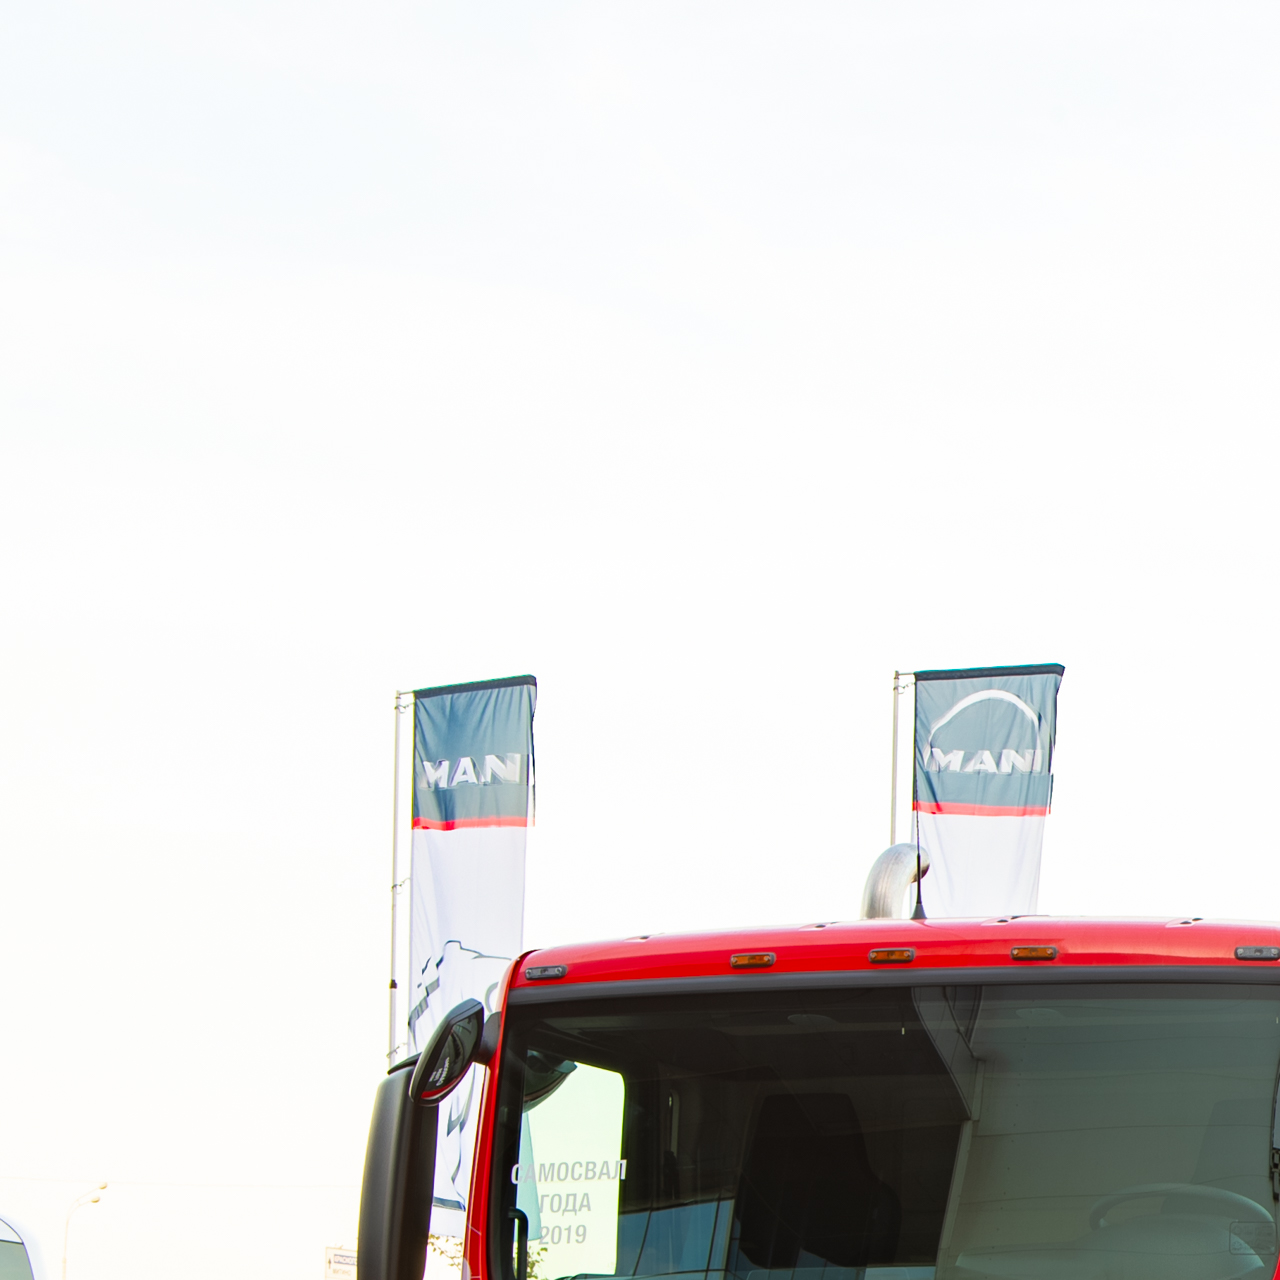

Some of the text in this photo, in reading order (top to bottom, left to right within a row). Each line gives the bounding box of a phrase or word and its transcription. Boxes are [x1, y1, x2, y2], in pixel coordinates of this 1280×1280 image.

[421, 752, 521, 791] MAN
[931, 748, 1043, 775] MAN
[511, 1159, 627, 1185] САМОСВАЛ
[540, 1193, 591, 1216] ГОДА
[538, 1225, 588, 1246] 2019
